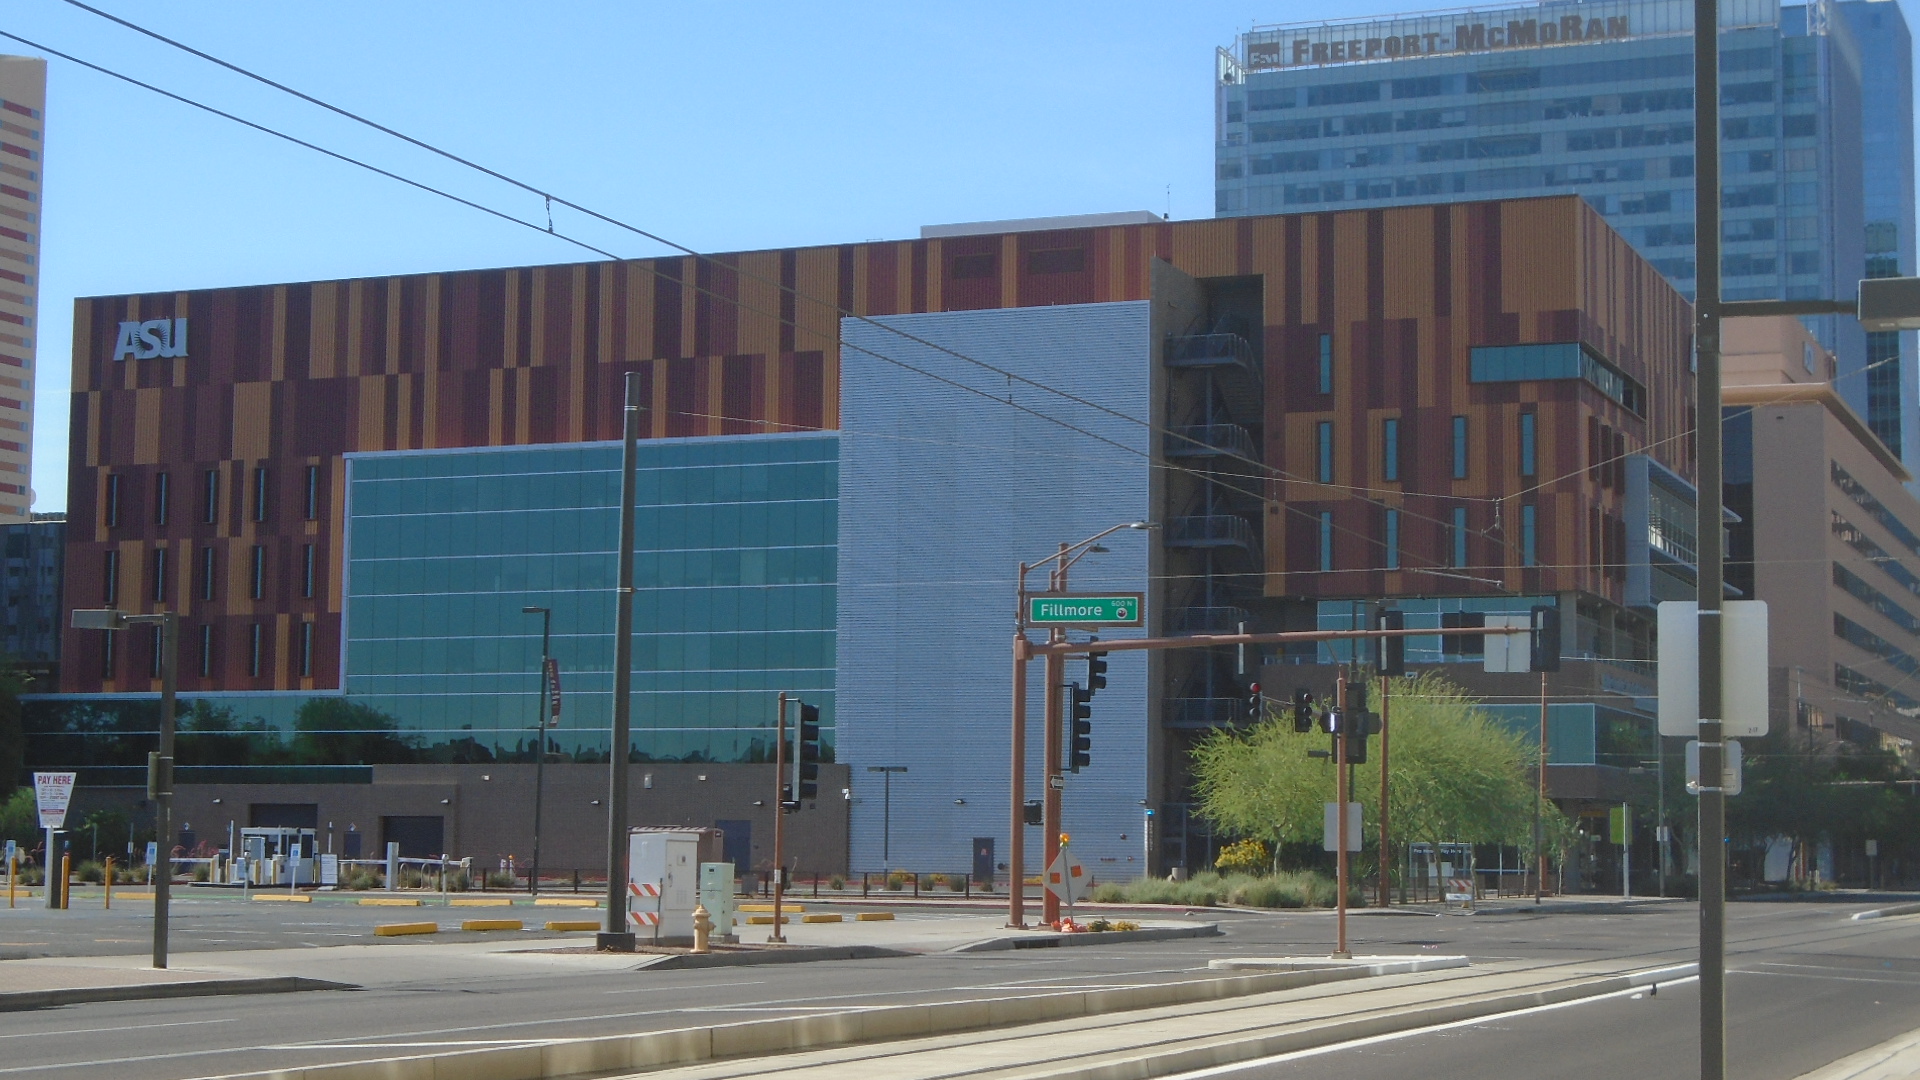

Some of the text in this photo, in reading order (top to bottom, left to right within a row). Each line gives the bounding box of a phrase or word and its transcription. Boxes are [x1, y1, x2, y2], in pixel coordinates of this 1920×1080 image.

[113, 318, 189, 361] ASU
[1041, 603, 1102, 616] Fillmore
[38, 775, 71, 785] PAY HERE
